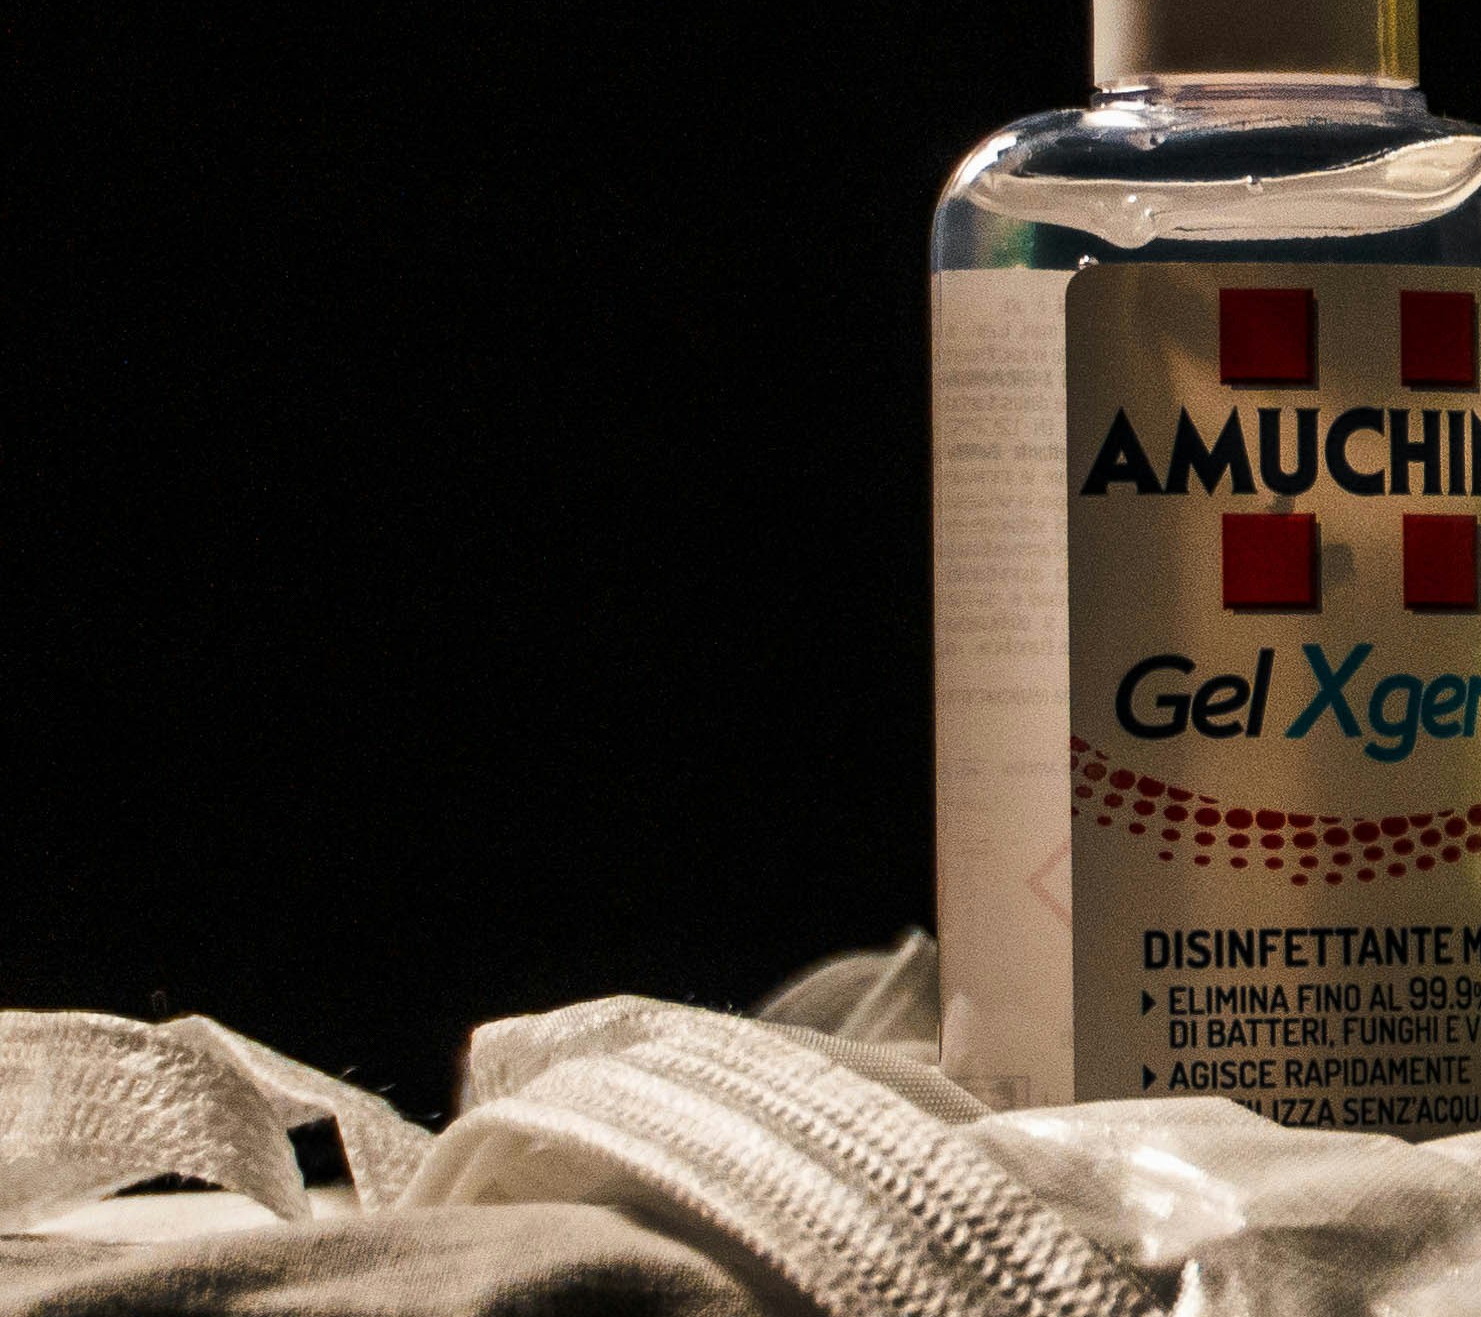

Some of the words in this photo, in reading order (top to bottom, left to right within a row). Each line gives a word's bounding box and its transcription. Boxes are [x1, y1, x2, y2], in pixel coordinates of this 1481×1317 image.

[1114, 647, 1276, 741] Gel
[1143, 925, 1455, 971] DISINFETTANTE
[1168, 985, 1290, 1016] ELIMINA
[1297, 983, 1361, 1014] FINO
[1369, 982, 1403, 1013] AL
[1168, 1019, 1198, 1049] DI
[1206, 1017, 1335, 1049] BATTERI,
[1343, 1015, 1439, 1046] FUNGHI
[1446, 1015, 1460, 1044] E
[1168, 1059, 1278, 1091] AGISCE
[1283, 1055, 1472, 1088] RAPIDAMENTE
